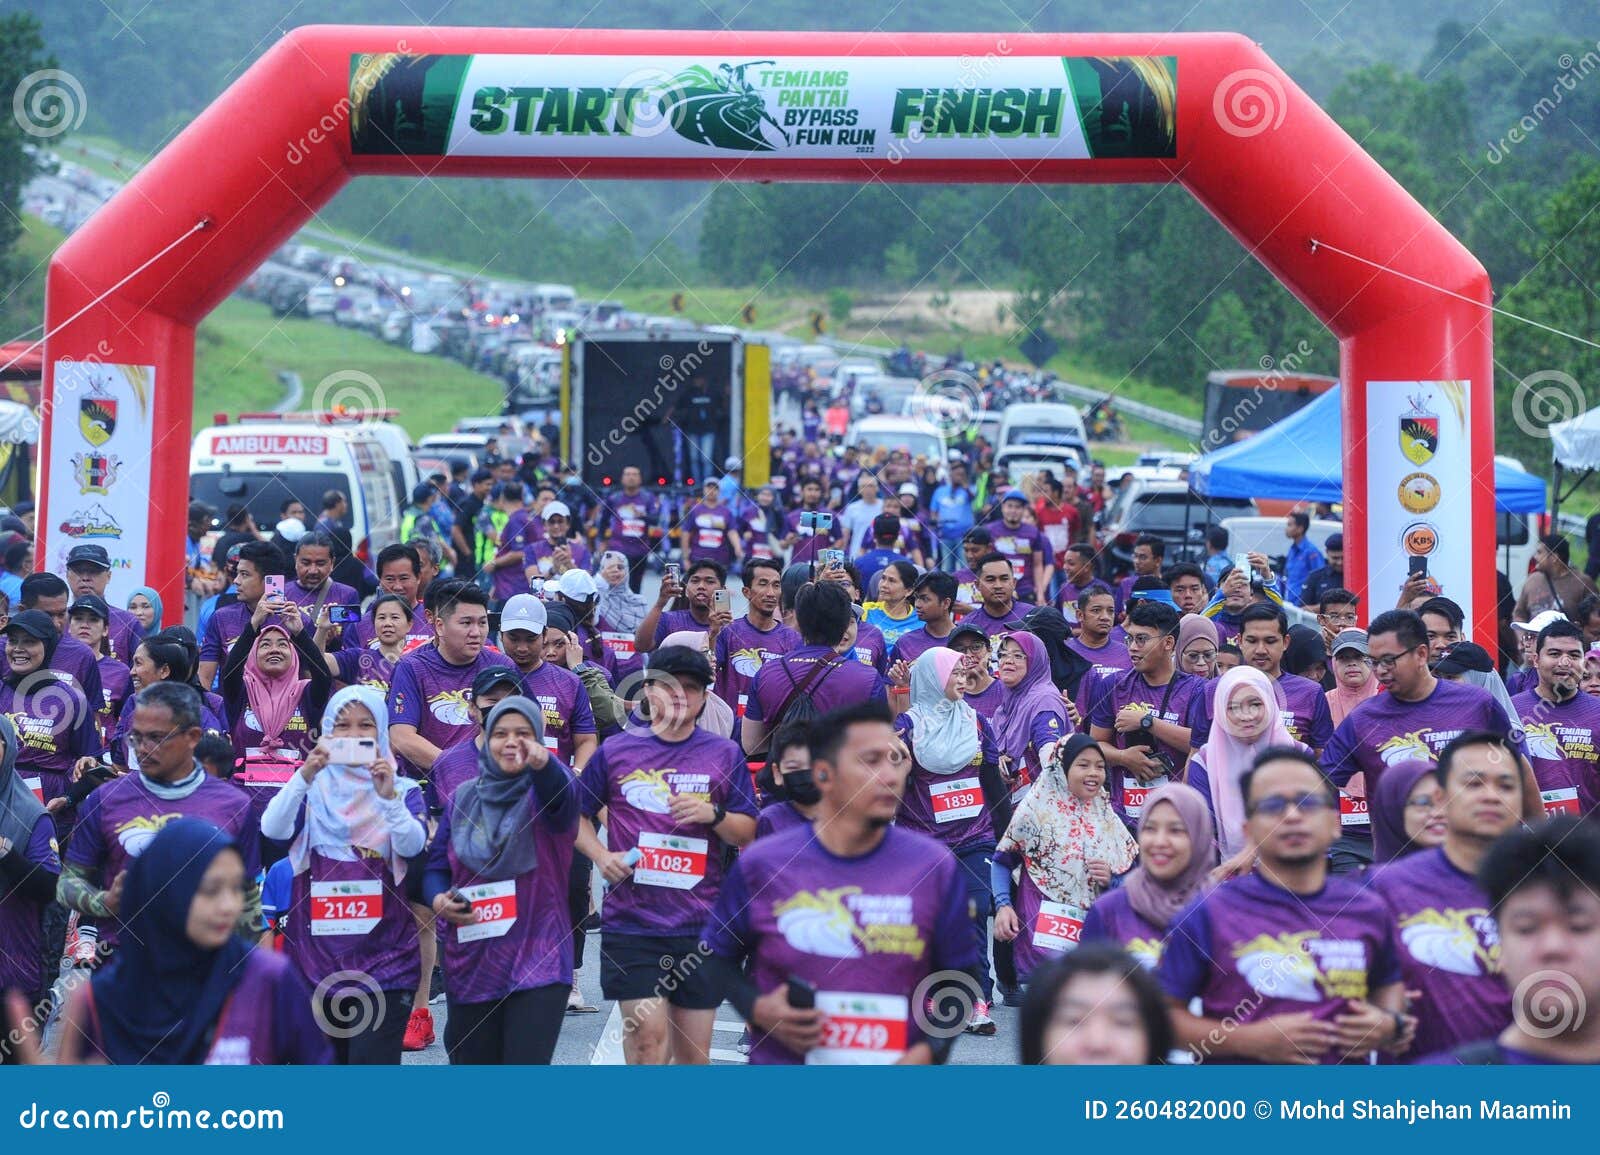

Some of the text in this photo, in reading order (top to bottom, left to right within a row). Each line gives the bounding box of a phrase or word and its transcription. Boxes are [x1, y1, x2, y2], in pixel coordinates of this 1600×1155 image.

[760, 70, 849, 88] TEMIANG
[778, 89, 849, 107] PANTAI
[469, 87, 648, 136] START
[783, 109, 859, 127] BYPASS
[890, 88, 1066, 139] FINISH
[795, 129, 876, 146] FUN RUN
[216, 436, 323, 453] AMBULANS
[1413, 536, 1433, 546] KBS
[1555, 727, 1592, 736] TEMIANG
[1562, 736, 1591, 744] PANTAI
[1564, 743, 1594, 752] BYPASS
[667, 774, 711, 784] TEMIANG
[675, 783, 710, 793] PANTAI
[943, 793, 975, 809] 1839
[652, 854, 693, 873] 1082
[324, 900, 368, 919] 2142
[823, 1021, 889, 1049] 2749
